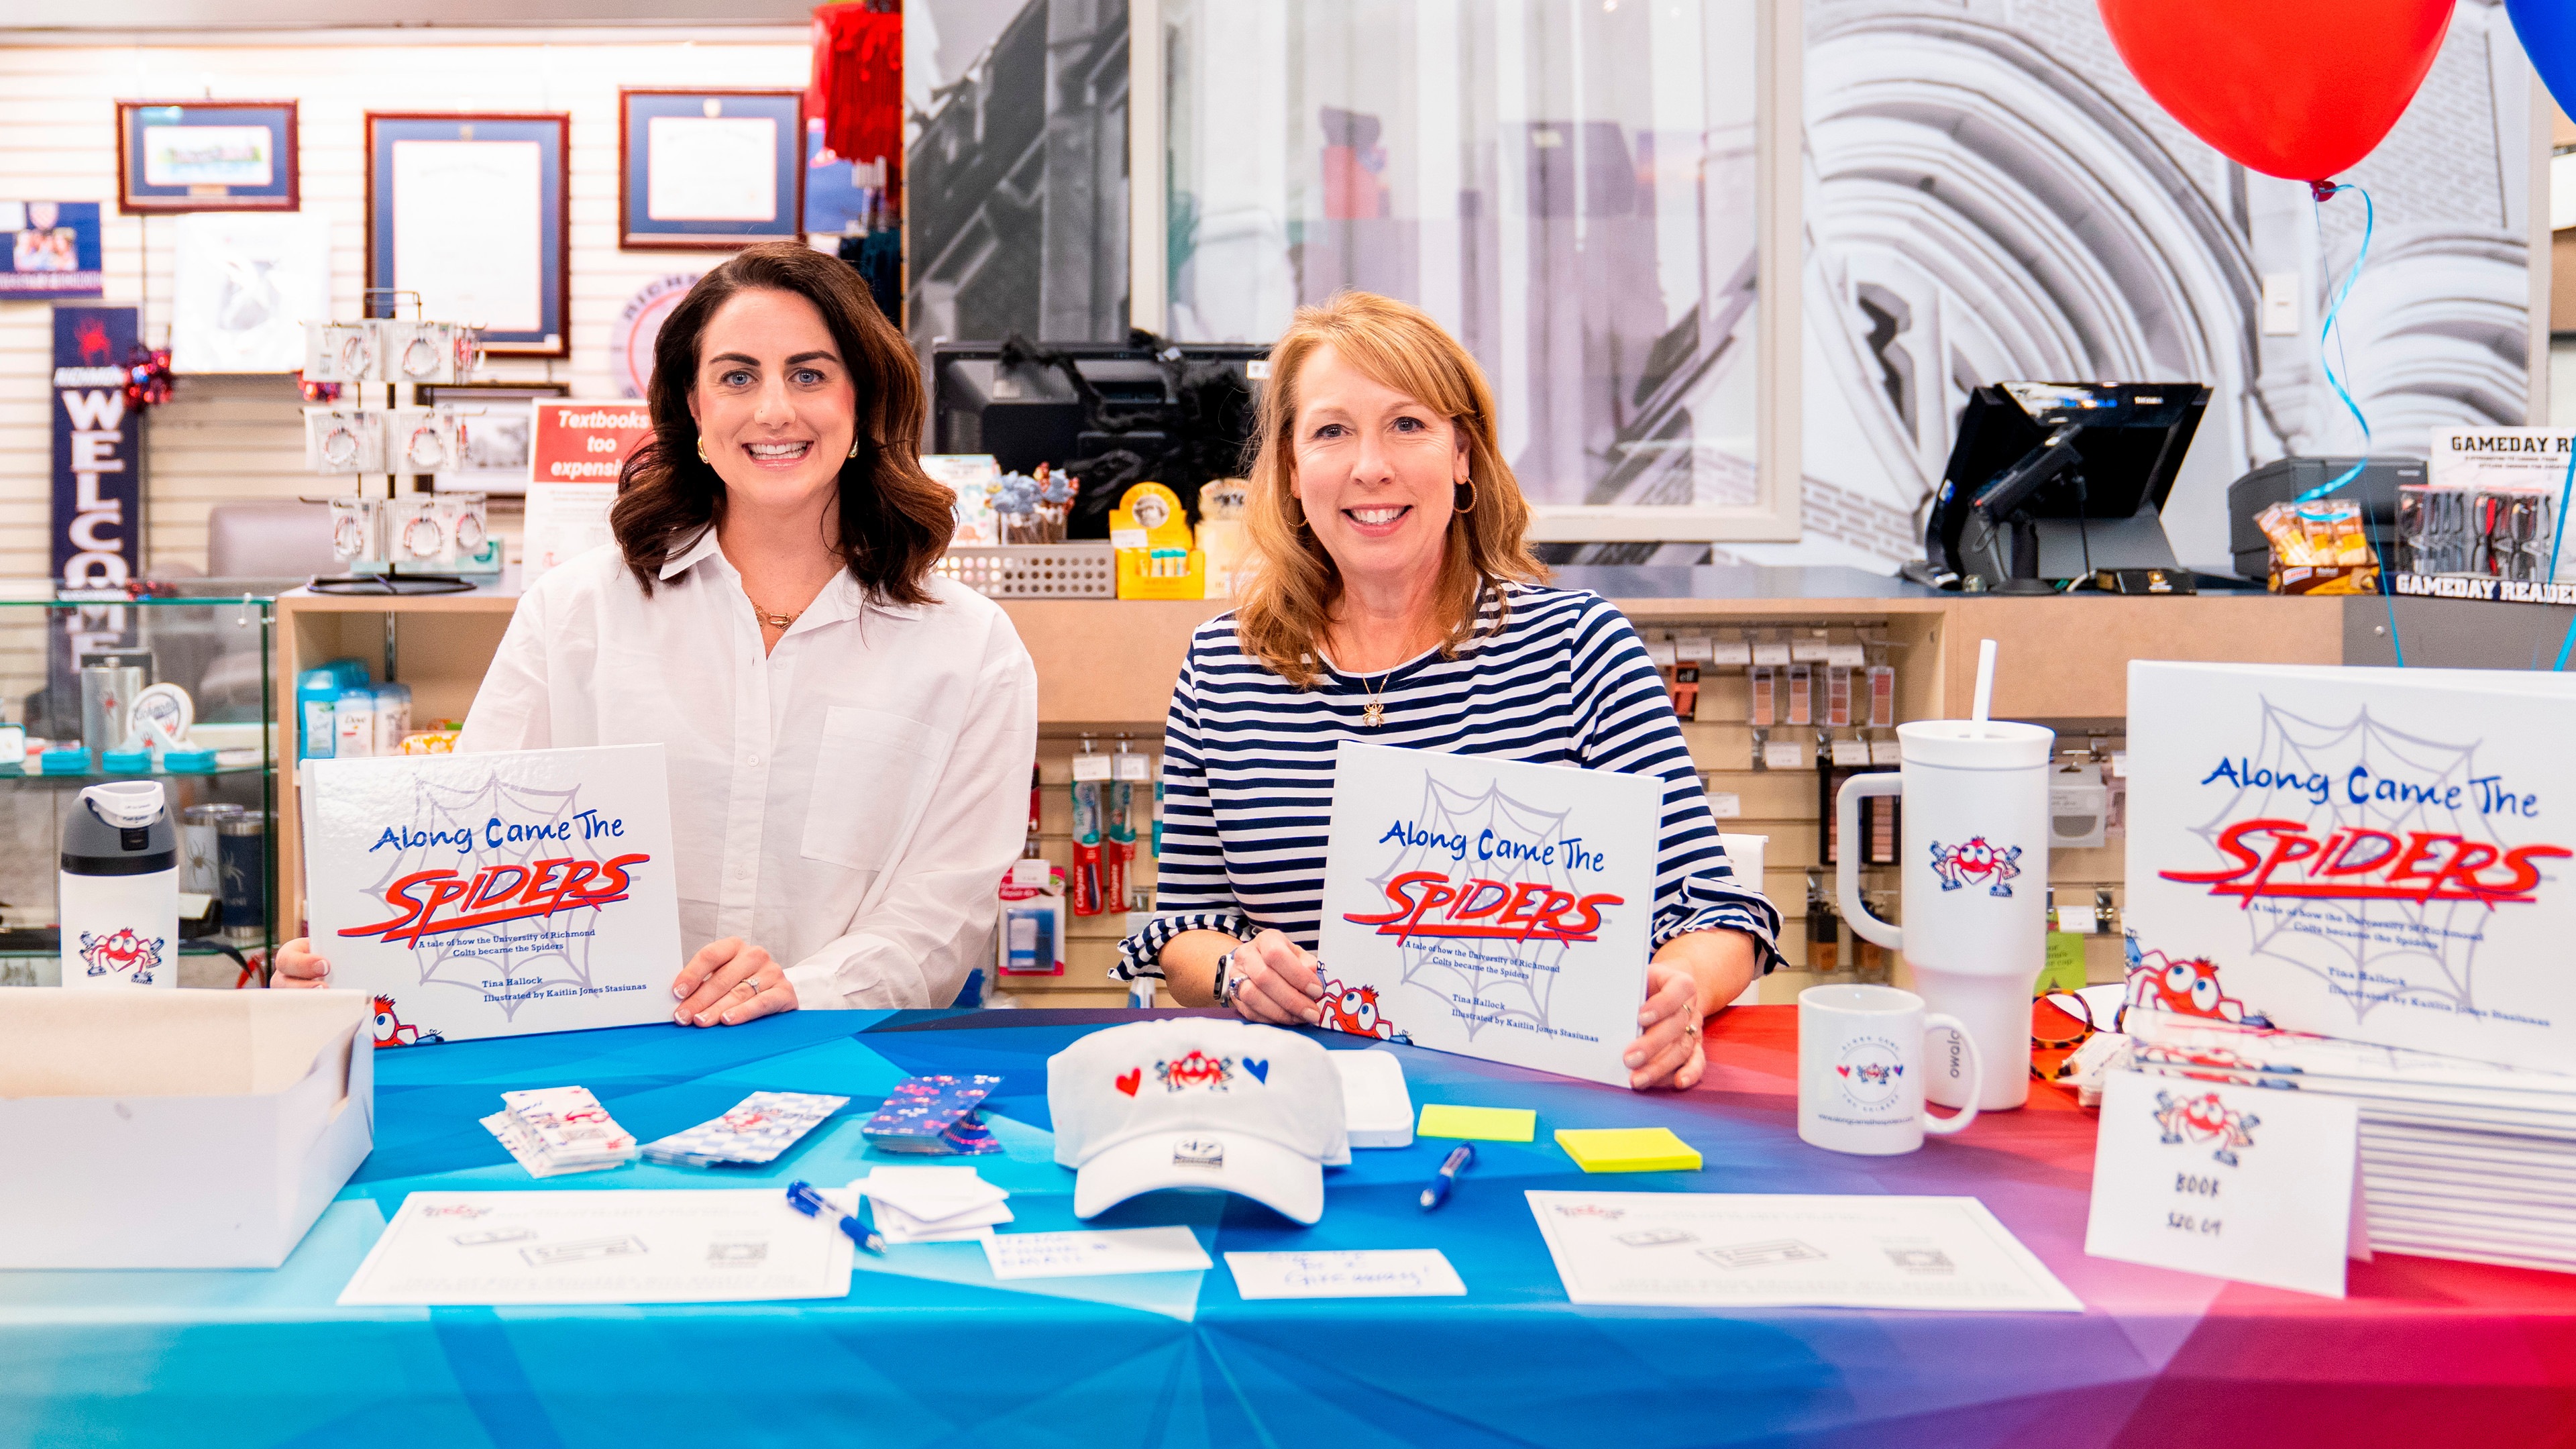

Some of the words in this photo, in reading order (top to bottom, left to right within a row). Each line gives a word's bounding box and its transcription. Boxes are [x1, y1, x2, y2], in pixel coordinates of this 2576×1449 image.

[558, 410, 649, 429] Textbooks
[587, 435, 616, 452] too
[2451, 435, 2548, 453] GAMEDAY
[551, 458, 623, 480] expensi
[2396, 574, 2497, 600] GAMEDAY
[2200, 757, 2329, 806] Along
[2348, 765, 2462, 810] Came
[2468, 775, 2539, 818] The
[369, 824, 473, 853] Along
[486, 818, 572, 849] Came
[573, 809, 625, 838] The
[1379, 820, 1466, 861] Along
[1478, 828, 1554, 865] Came
[1558, 838, 1604, 871] The
[2158, 817, 2573, 912] SPIDERS
[337, 853, 650, 950] SPIDERS
[1343, 870, 1625, 949] SPIDERS
[427, 939, 444, 948] tale
[446, 938, 458, 947] of
[457, 937, 475, 946] how
[477, 936, 492, 945] the
[493, 933, 538, 945] University
[540, 932, 550, 940] of
[550, 928, 596, 939] Richmond
[453, 948, 476, 957] Colts
[478, 946, 513, 956] became
[515, 944, 529, 953] the
[531, 943, 564, 953] Spiders
[1412, 942, 1426, 951] tale
[1428, 944, 1438, 953] of
[1438, 945, 1452, 955] how
[1454, 948, 1466, 957] the
[1468, 951, 1508, 965] University
[1510, 957, 1519, 966] of
[1519, 959, 1560, 973] Richmond
[1432, 956, 1452, 967] Colts
[1454, 960, 1485, 972] became
[1486, 965, 1499, 974] the
[1500, 967, 1529, 980] Spiders
[482, 979, 504, 988] Tina
[506, 976, 543, 987] Hallock
[484, 991, 531, 1002] Illustrated
[533, 990, 545, 1000] by
[546, 988, 578, 998] Kaitlin
[579, 987, 603, 997] Jones
[604, 983, 647, 994] Stasiunas
[1452, 994, 1471, 1004] Tina
[1472, 997, 1506, 1011] Hallock
[1451, 1009, 1493, 1023] Illustrated
[1495, 1017, 1504, 1026] by
[1506, 1018, 1534, 1031] Kaitlin
[1536, 1024, 1558, 1036] Jones
[1559, 1028, 1599, 1042] Stasiunas
[2175, 1172, 2218, 1197] BOOK
